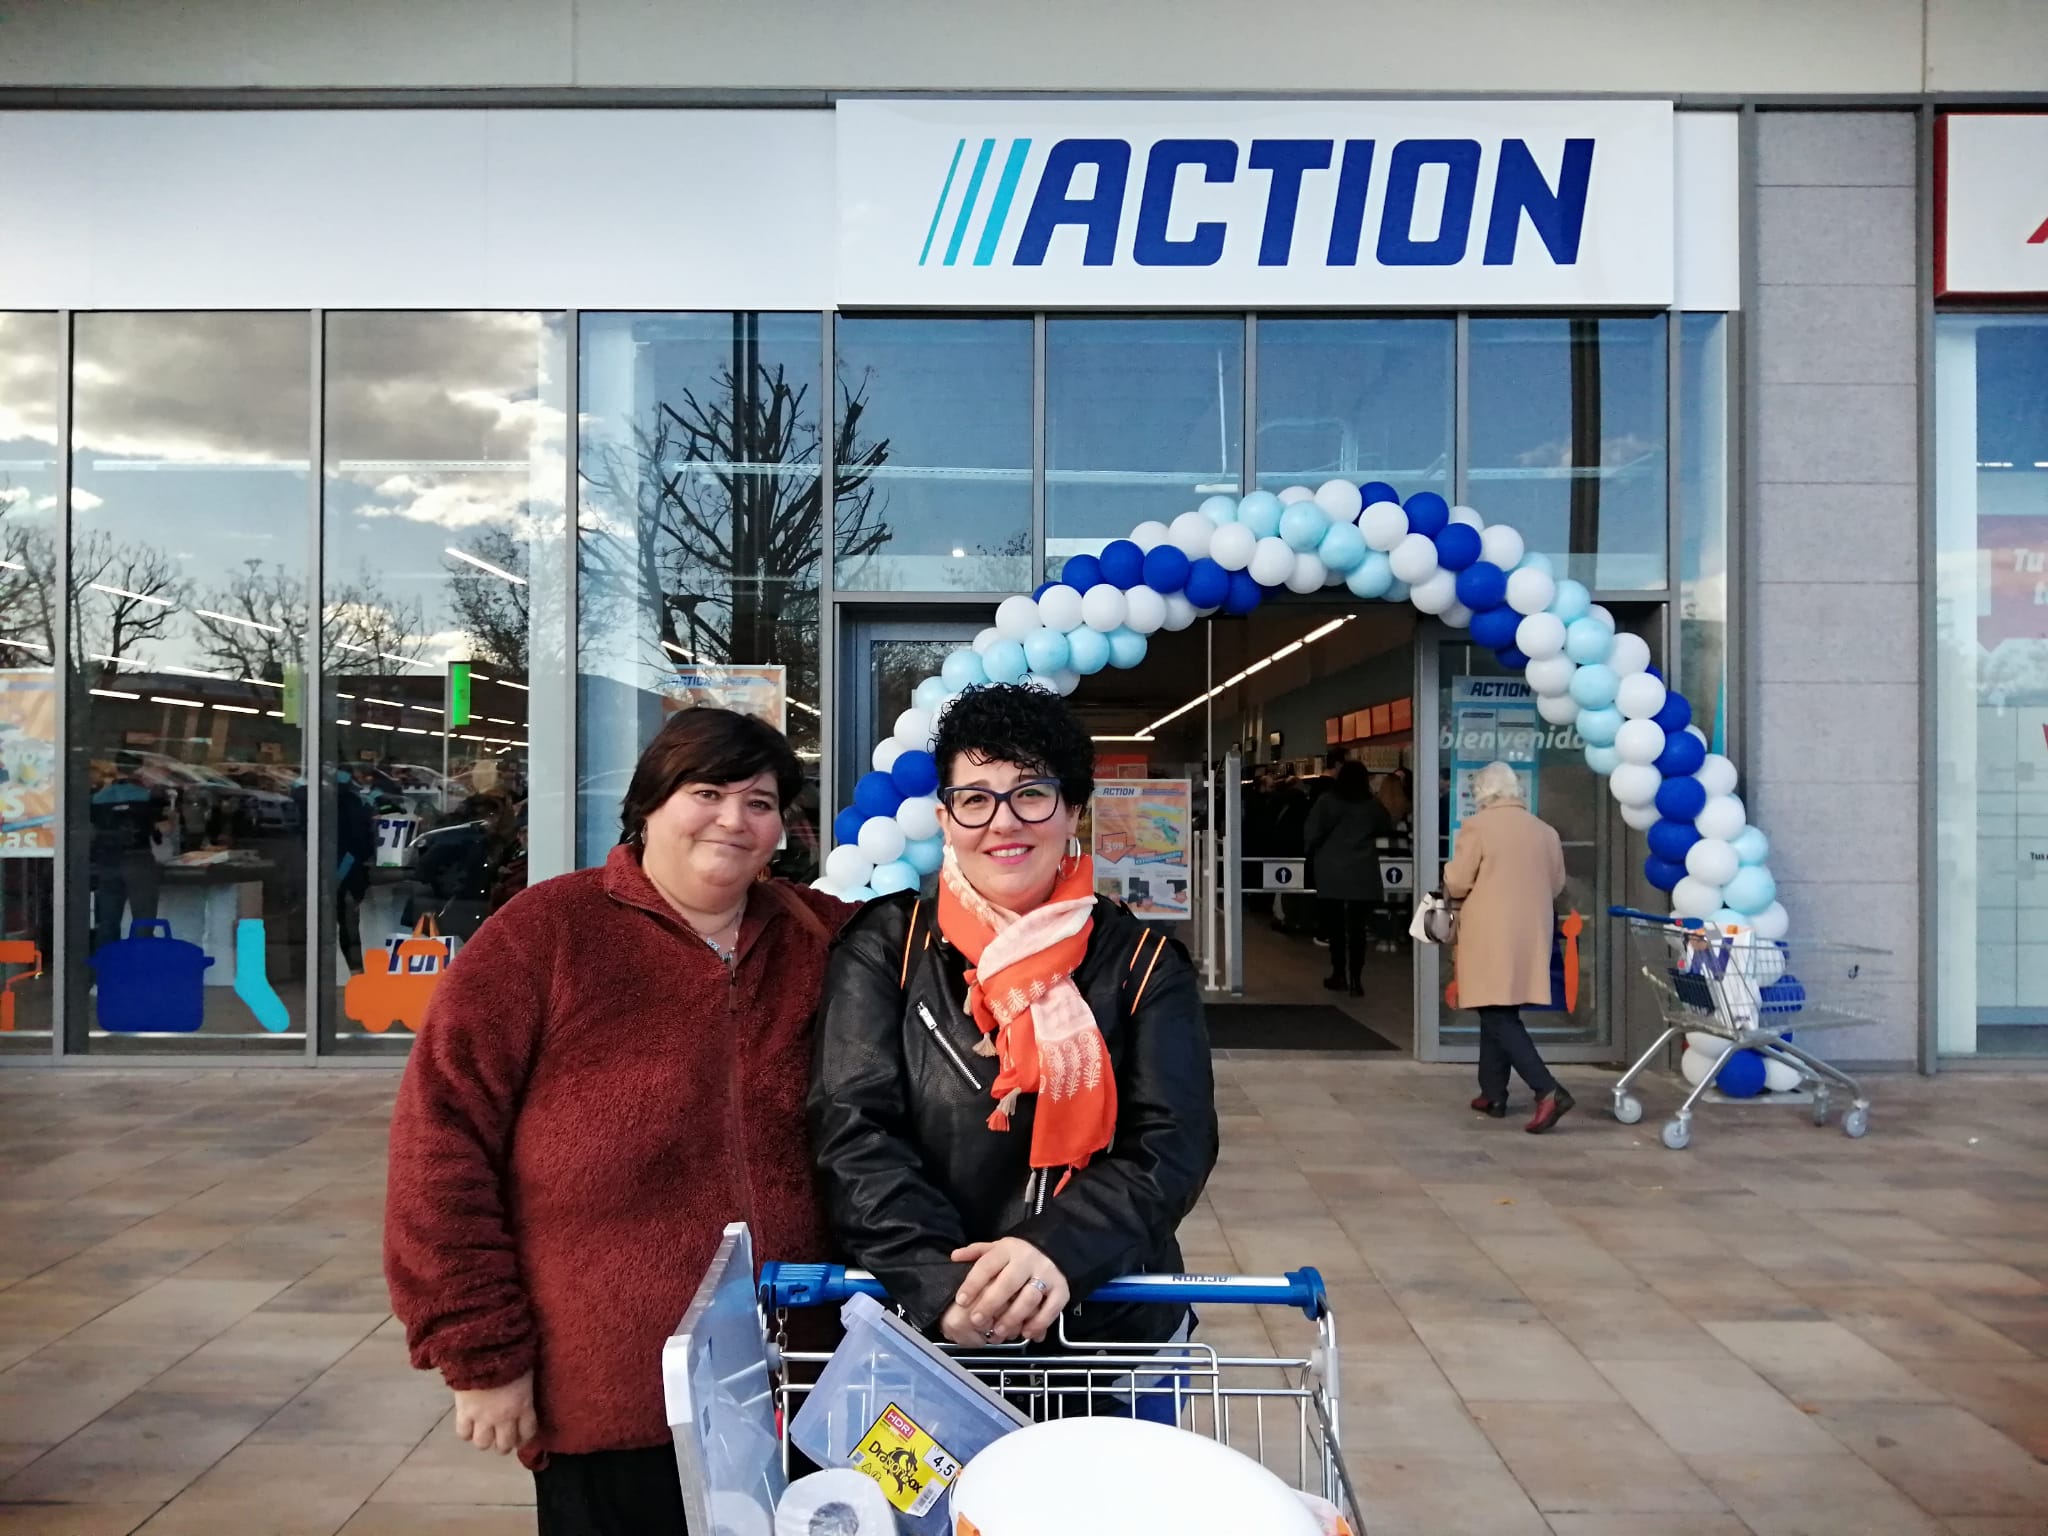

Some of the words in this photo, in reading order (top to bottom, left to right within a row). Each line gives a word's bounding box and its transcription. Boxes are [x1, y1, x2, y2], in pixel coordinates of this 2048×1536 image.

[1012, 138, 1597, 266] ACTION
[1470, 681, 1532, 697] ACTION
[1102, 787, 1135, 796] ACTION
[1171, 1273, 1231, 1283] ACTION
[933, 1456, 956, 1477] 4,5
